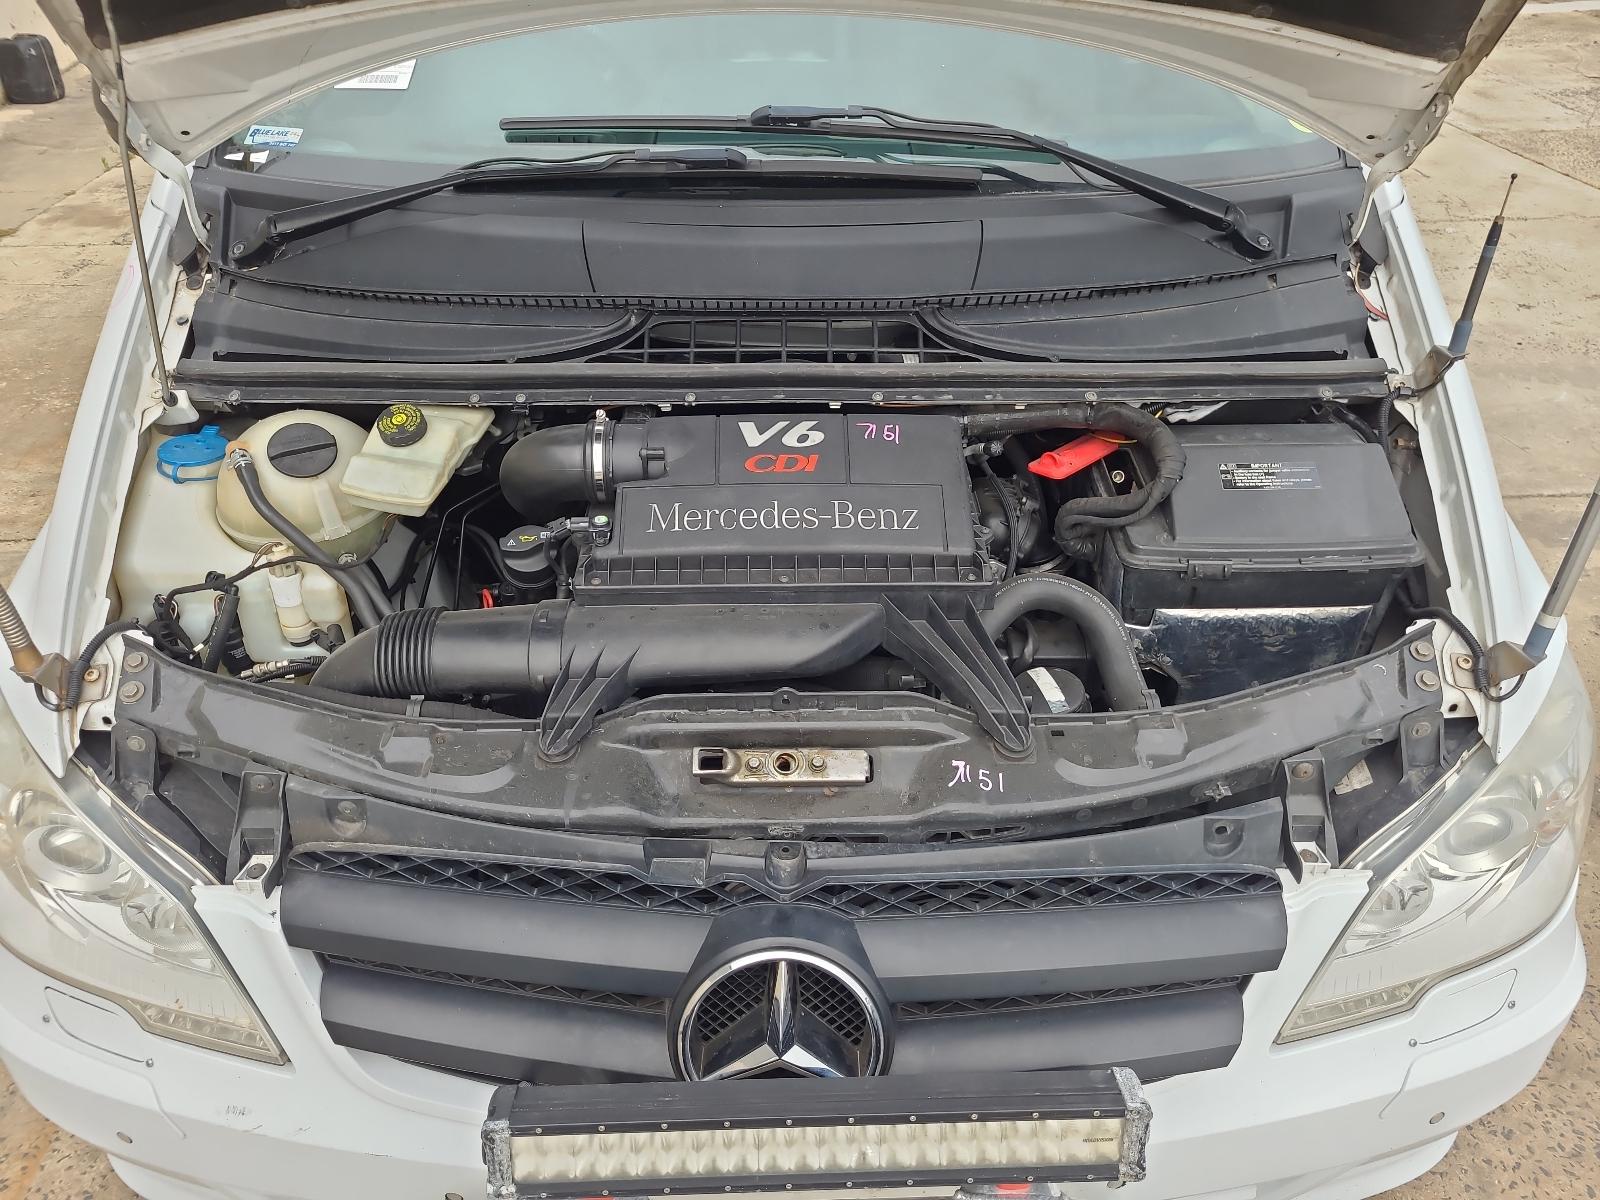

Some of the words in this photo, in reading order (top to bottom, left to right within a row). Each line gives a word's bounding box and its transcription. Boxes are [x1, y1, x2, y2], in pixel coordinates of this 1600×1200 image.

[738, 420, 825, 448] V6
[744, 454, 820, 473] CDI
[645, 500, 920, 533] Mercedes-Benz
